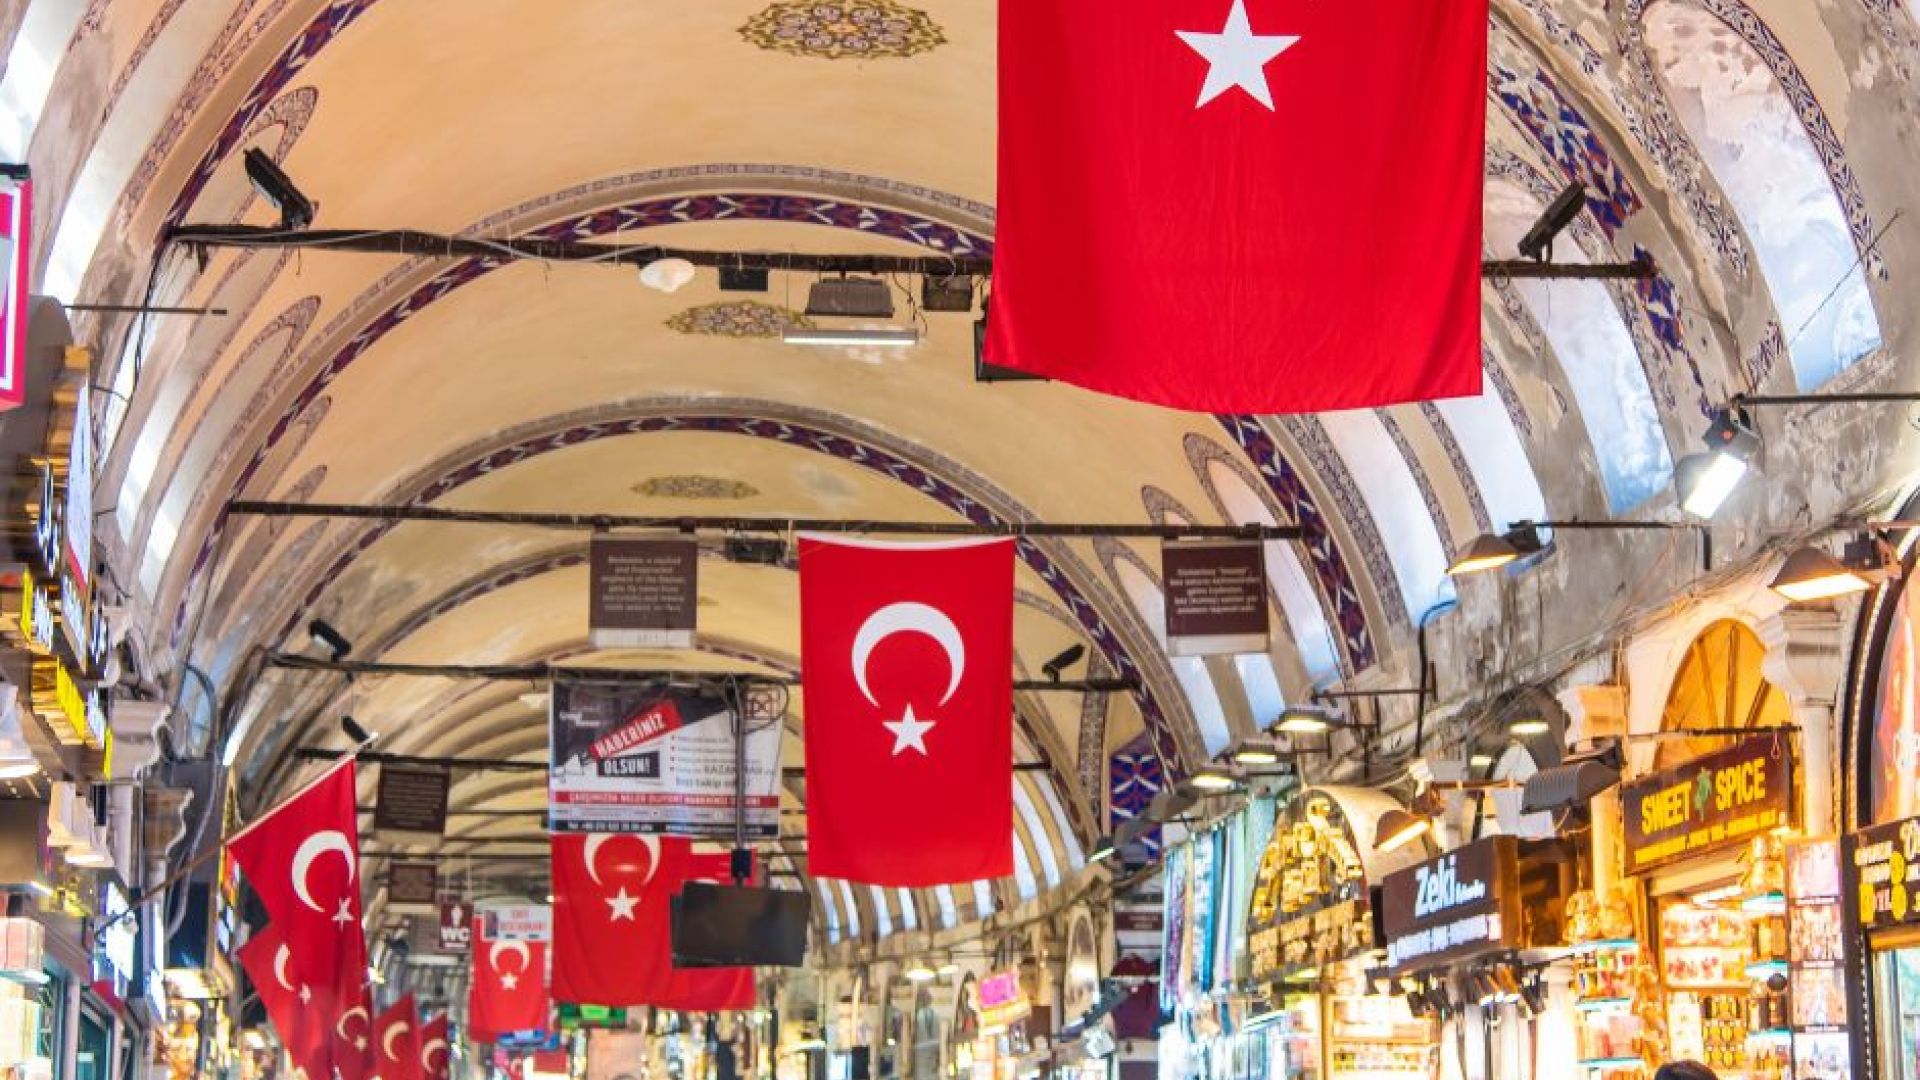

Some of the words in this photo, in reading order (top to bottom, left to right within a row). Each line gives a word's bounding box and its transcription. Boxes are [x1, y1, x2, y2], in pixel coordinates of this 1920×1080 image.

[595, 711, 666, 757] HABERİNİZ
[604, 757, 650, 775] OLSUN!
[1641, 780, 1692, 836] SWEET
[1715, 757, 1766, 811] SPICE
[1415, 853, 1457, 917] Zeki
[440, 927, 471, 941] WC
